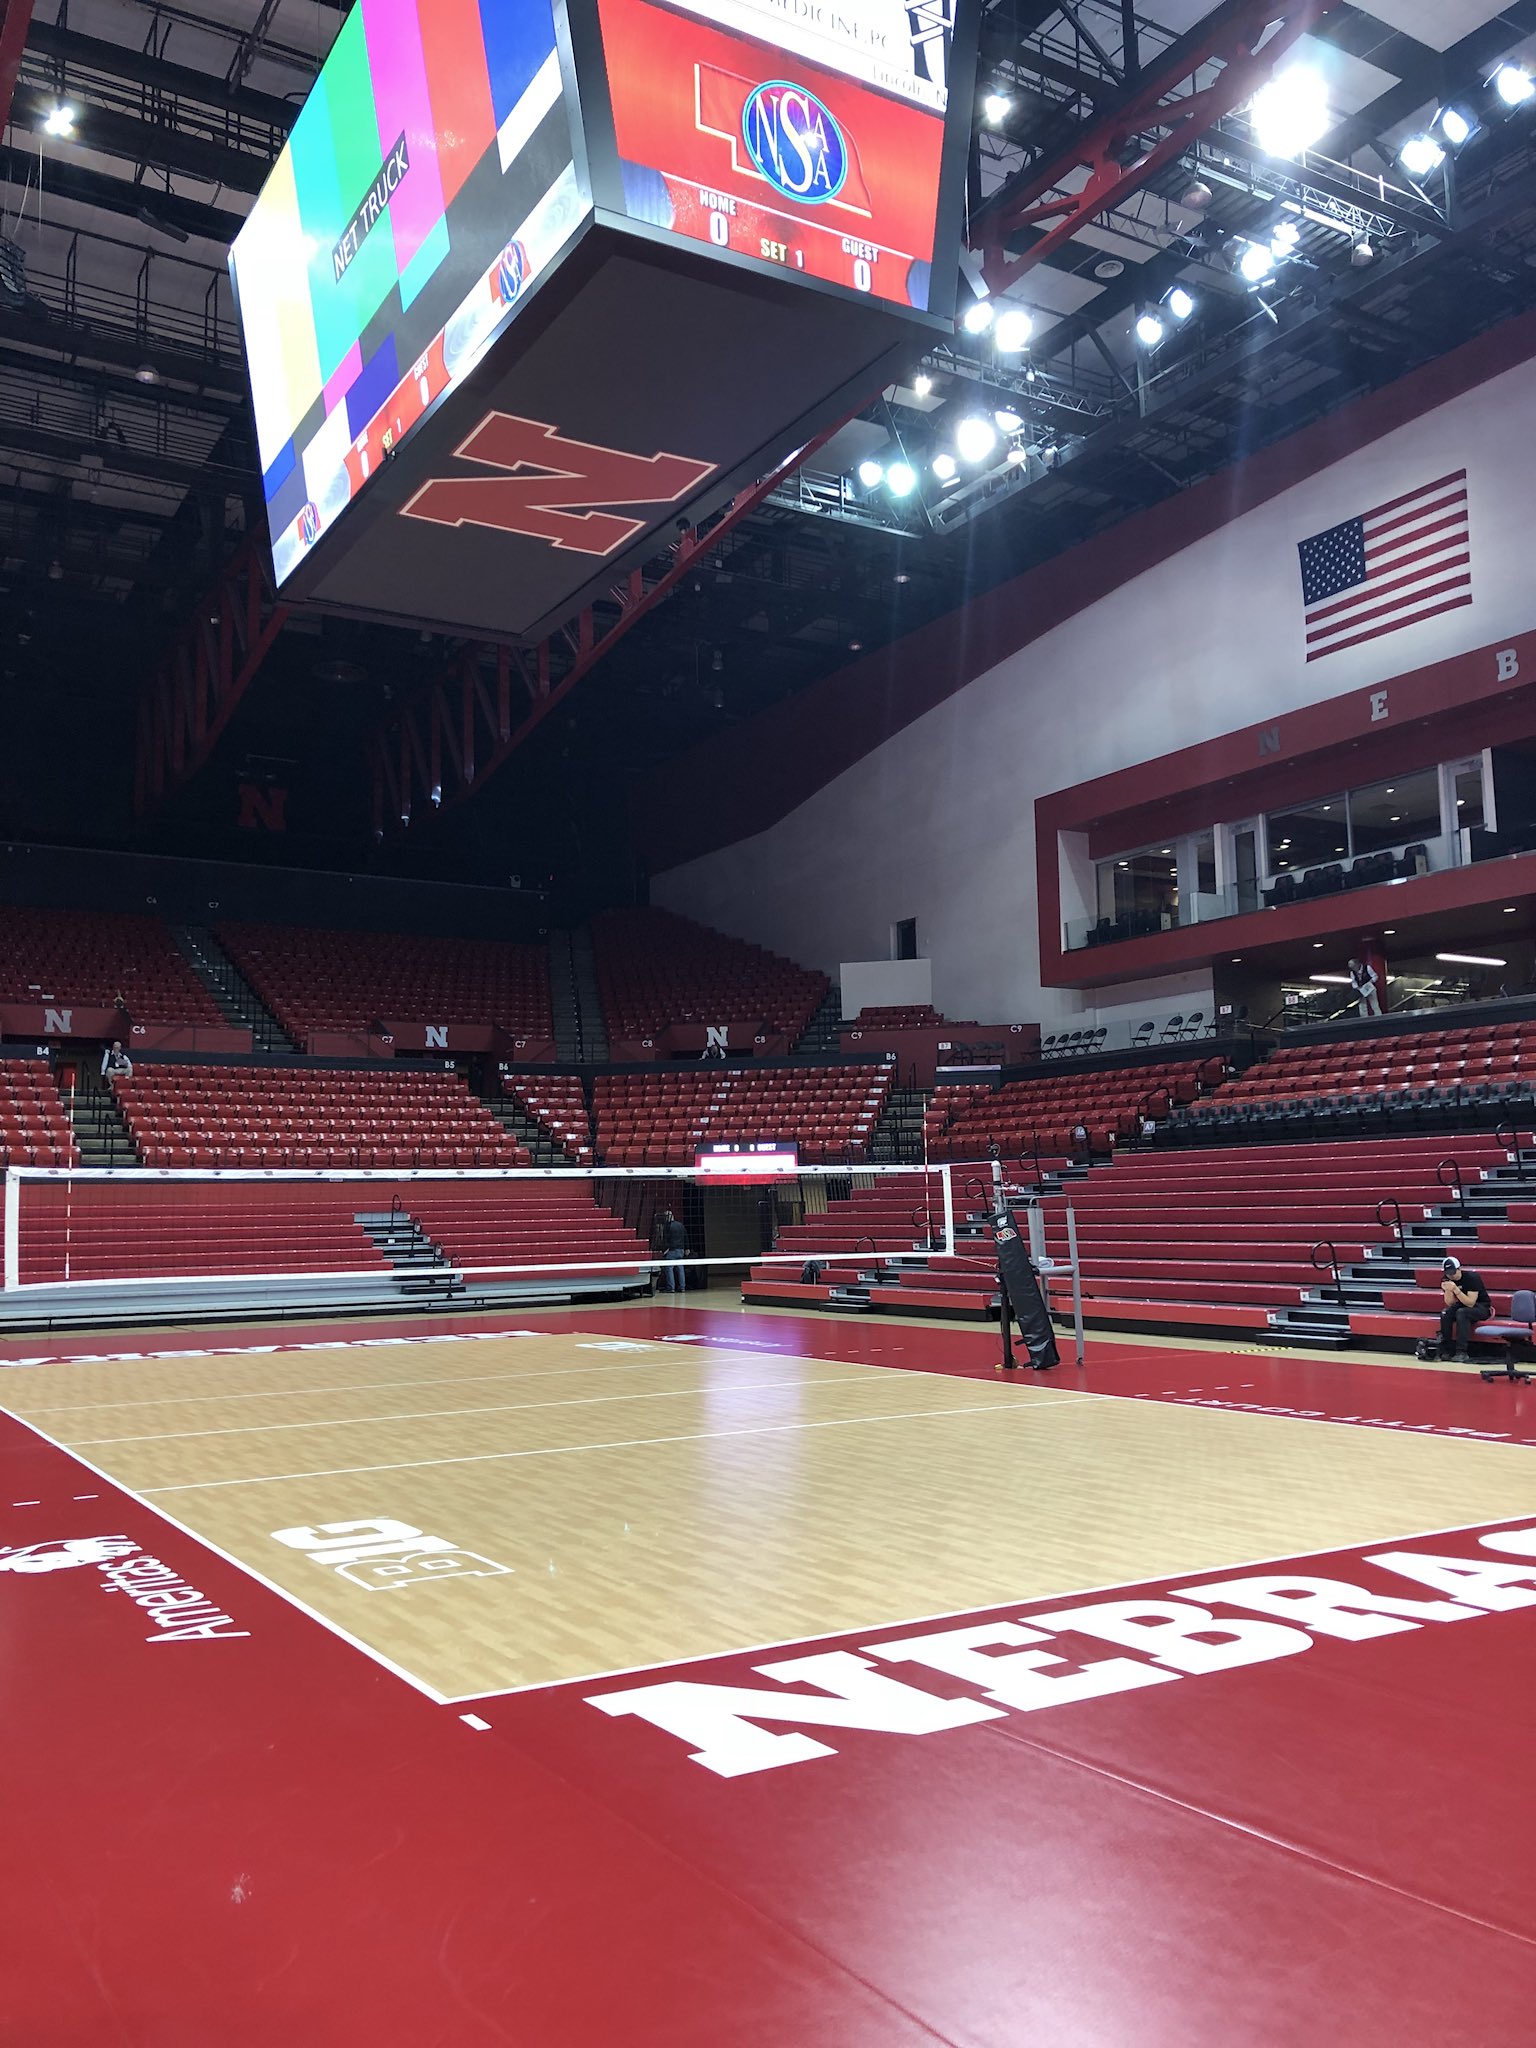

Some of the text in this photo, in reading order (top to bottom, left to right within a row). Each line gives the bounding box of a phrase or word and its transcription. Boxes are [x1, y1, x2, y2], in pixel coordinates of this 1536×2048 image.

[333, 140, 409, 280] NET TRUCK
[699, 190, 737, 216] HOME
[709, 211, 729, 247] 0
[760, 238, 804, 268] SET 1
[842, 237, 879, 263] GUEST
[853, 258, 871, 292] 0
[397, 410, 720, 557] N
[1369, 690, 1389, 722] E
[1496, 648, 1520, 682] B
[44, 1008, 73, 1034] N
[132, 1025, 146, 1035] C6
[1010, 1025, 1023, 1034] C9
[425, 1026, 449, 1048] N
[514, 1040, 526, 1049] C7
[706, 1026, 729, 1048] N
[850, 1031, 863, 1040] C9
[36, 1046, 50, 1056] B4
[885, 1052, 897, 1061] B6
[444, 1060, 456, 1069] B5
[1173, 1398, 1512, 1438] PETTIT COURT
[97, 1556, 251, 1642] Ameritas
